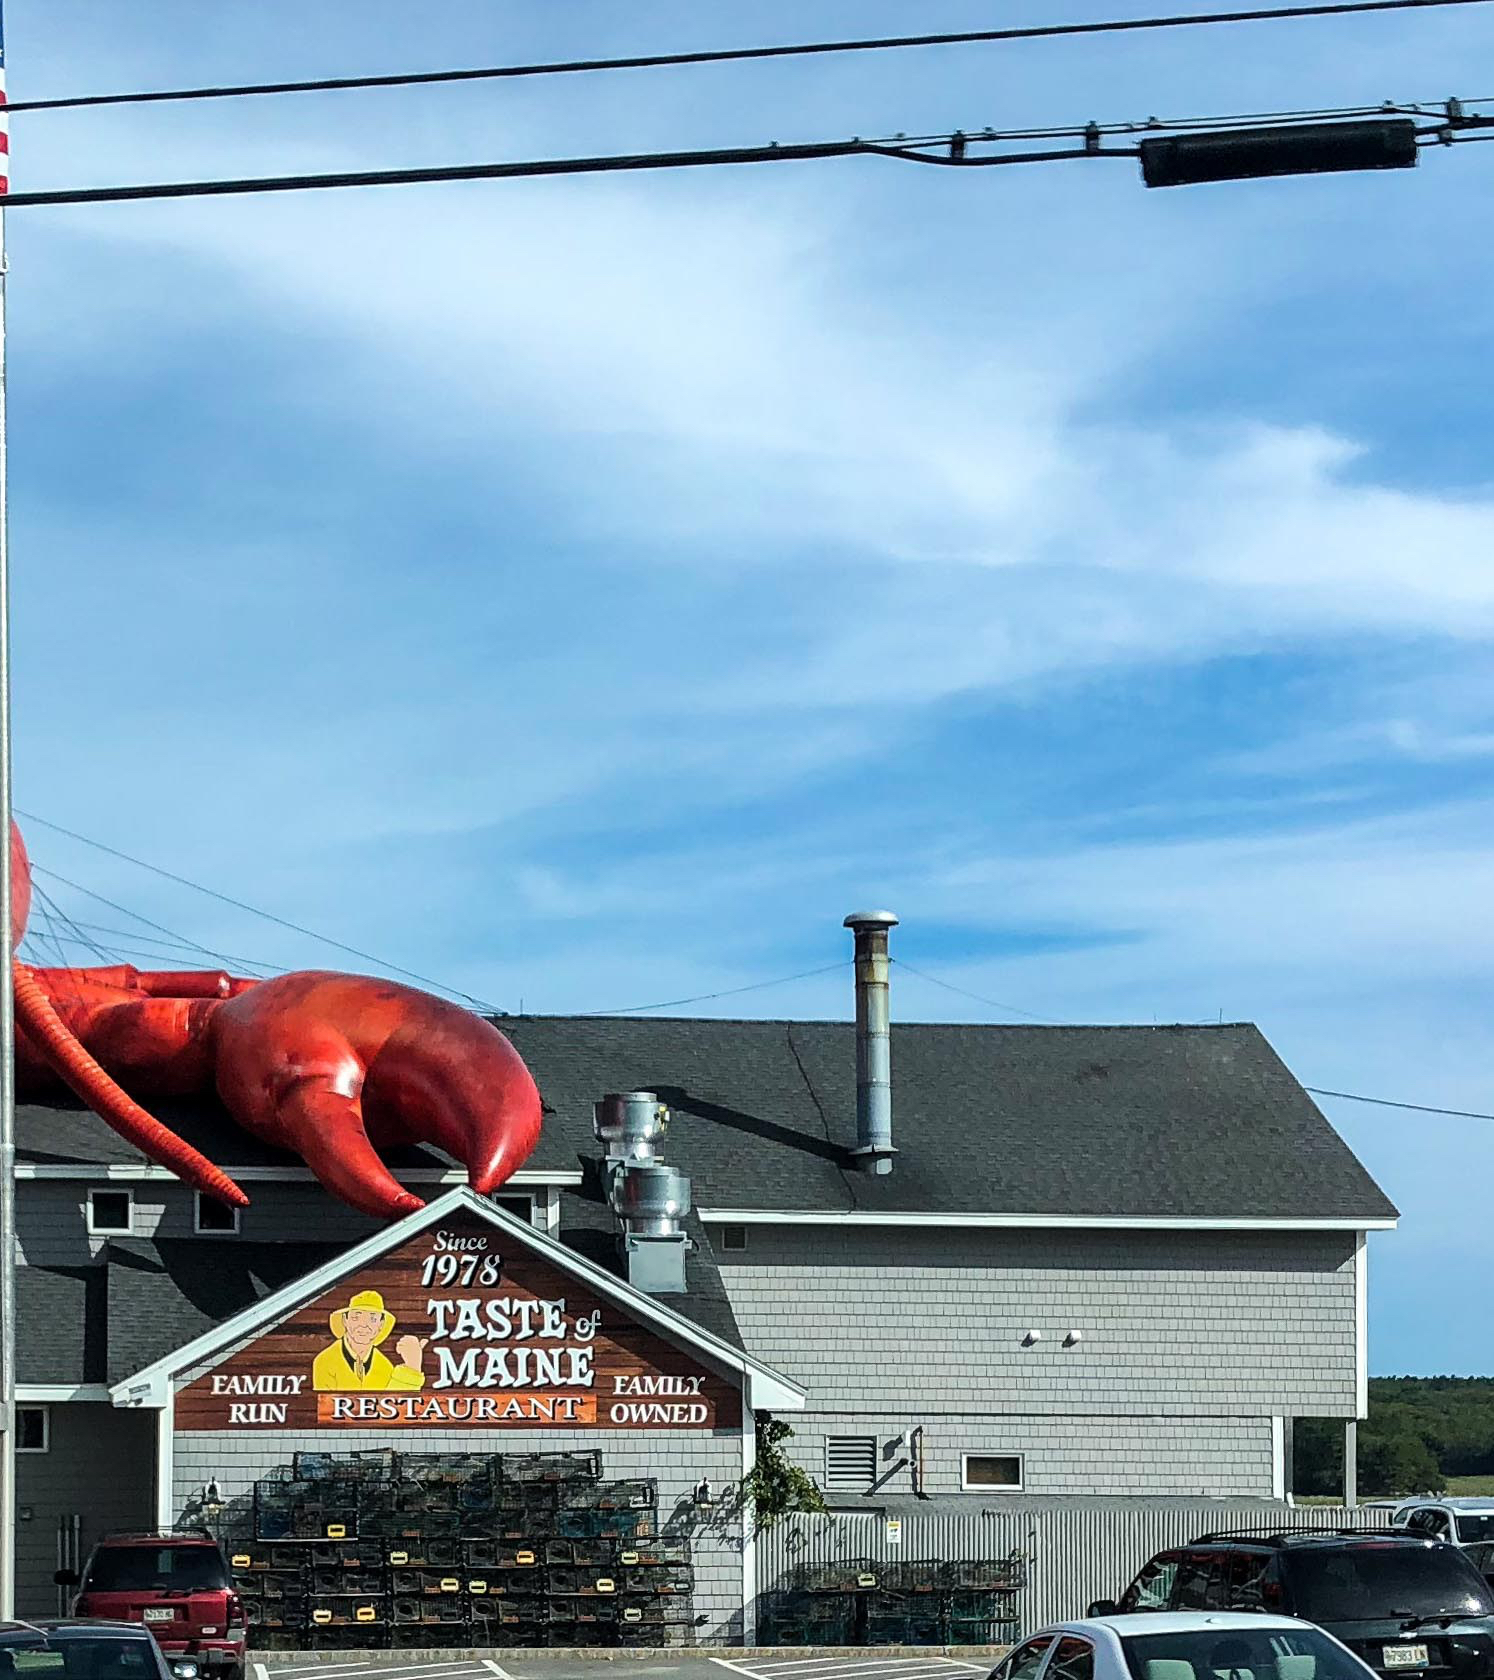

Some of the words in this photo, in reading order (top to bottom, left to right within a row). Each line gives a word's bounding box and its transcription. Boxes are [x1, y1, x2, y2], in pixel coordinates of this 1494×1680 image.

[433, 1230, 488, 1251] Since
[421, 1254, 501, 1286] 1978
[427, 1297, 568, 1341] TASTE
[574, 1309, 602, 1342] of
[432, 1346, 595, 1389] MAINE
[210, 1375, 307, 1395] FAMILY
[613, 1375, 706, 1396] FAMILY
[228, 1403, 289, 1424] RUN
[331, 1397, 583, 1420] RESTAURANT
[610, 1403, 709, 1424] OWNED
